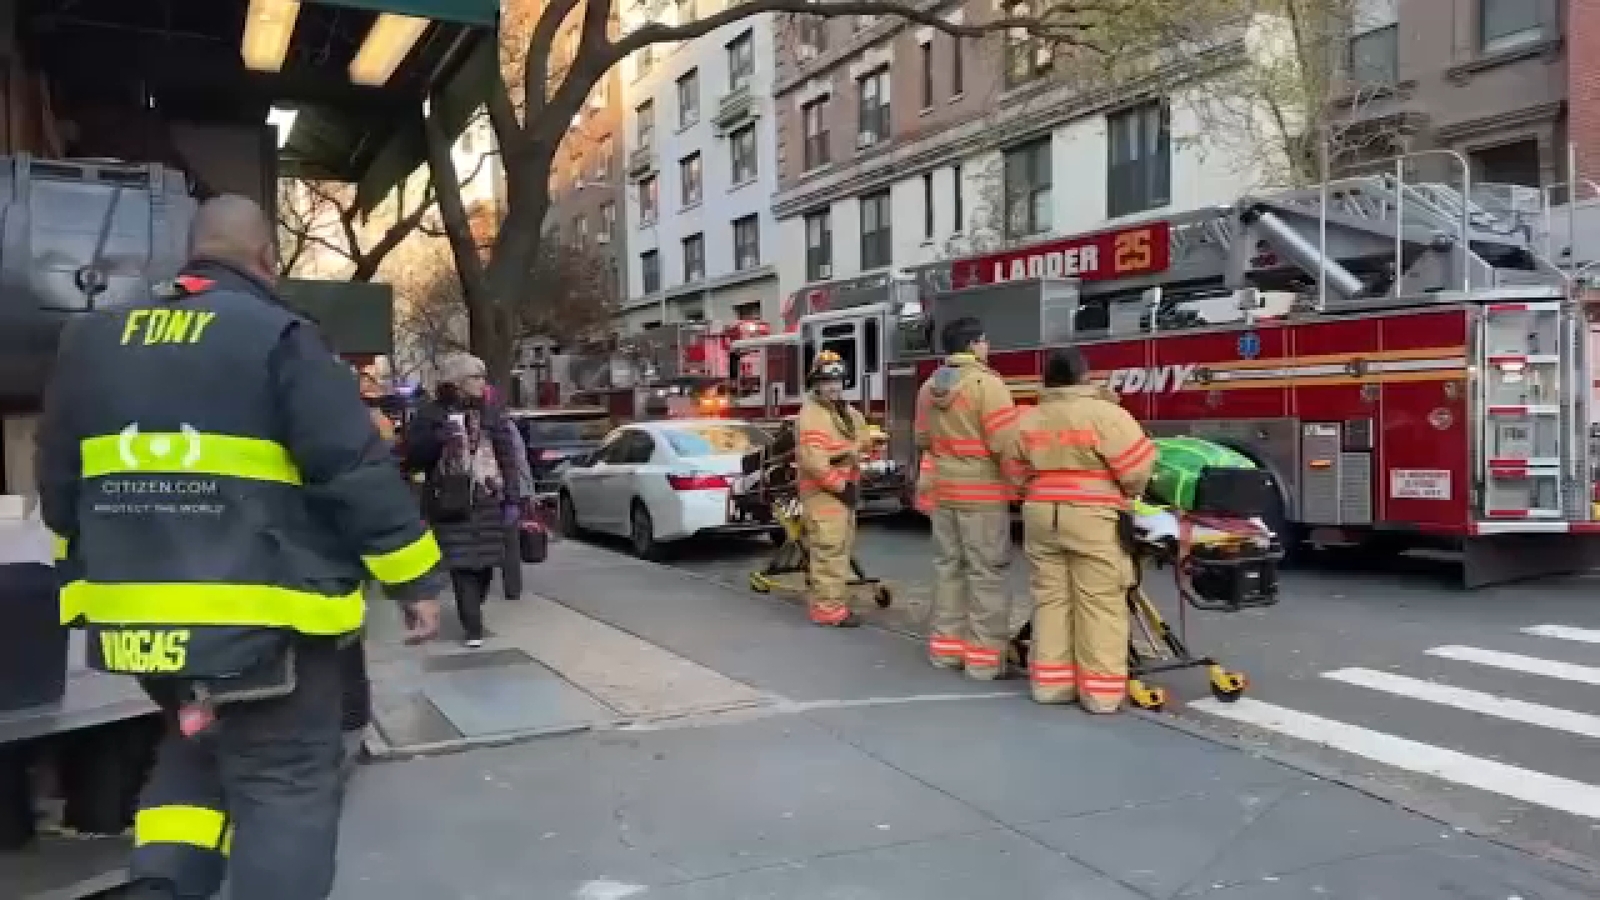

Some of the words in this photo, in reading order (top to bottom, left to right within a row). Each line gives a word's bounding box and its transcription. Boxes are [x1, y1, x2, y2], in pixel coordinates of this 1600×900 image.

[994, 244, 1099, 284] LADDER
[1114, 229, 1151, 271] 25
[120, 308, 216, 346] FDNY
[1109, 364, 1196, 394] FDNY
[99, 629, 191, 673] VARGAS
